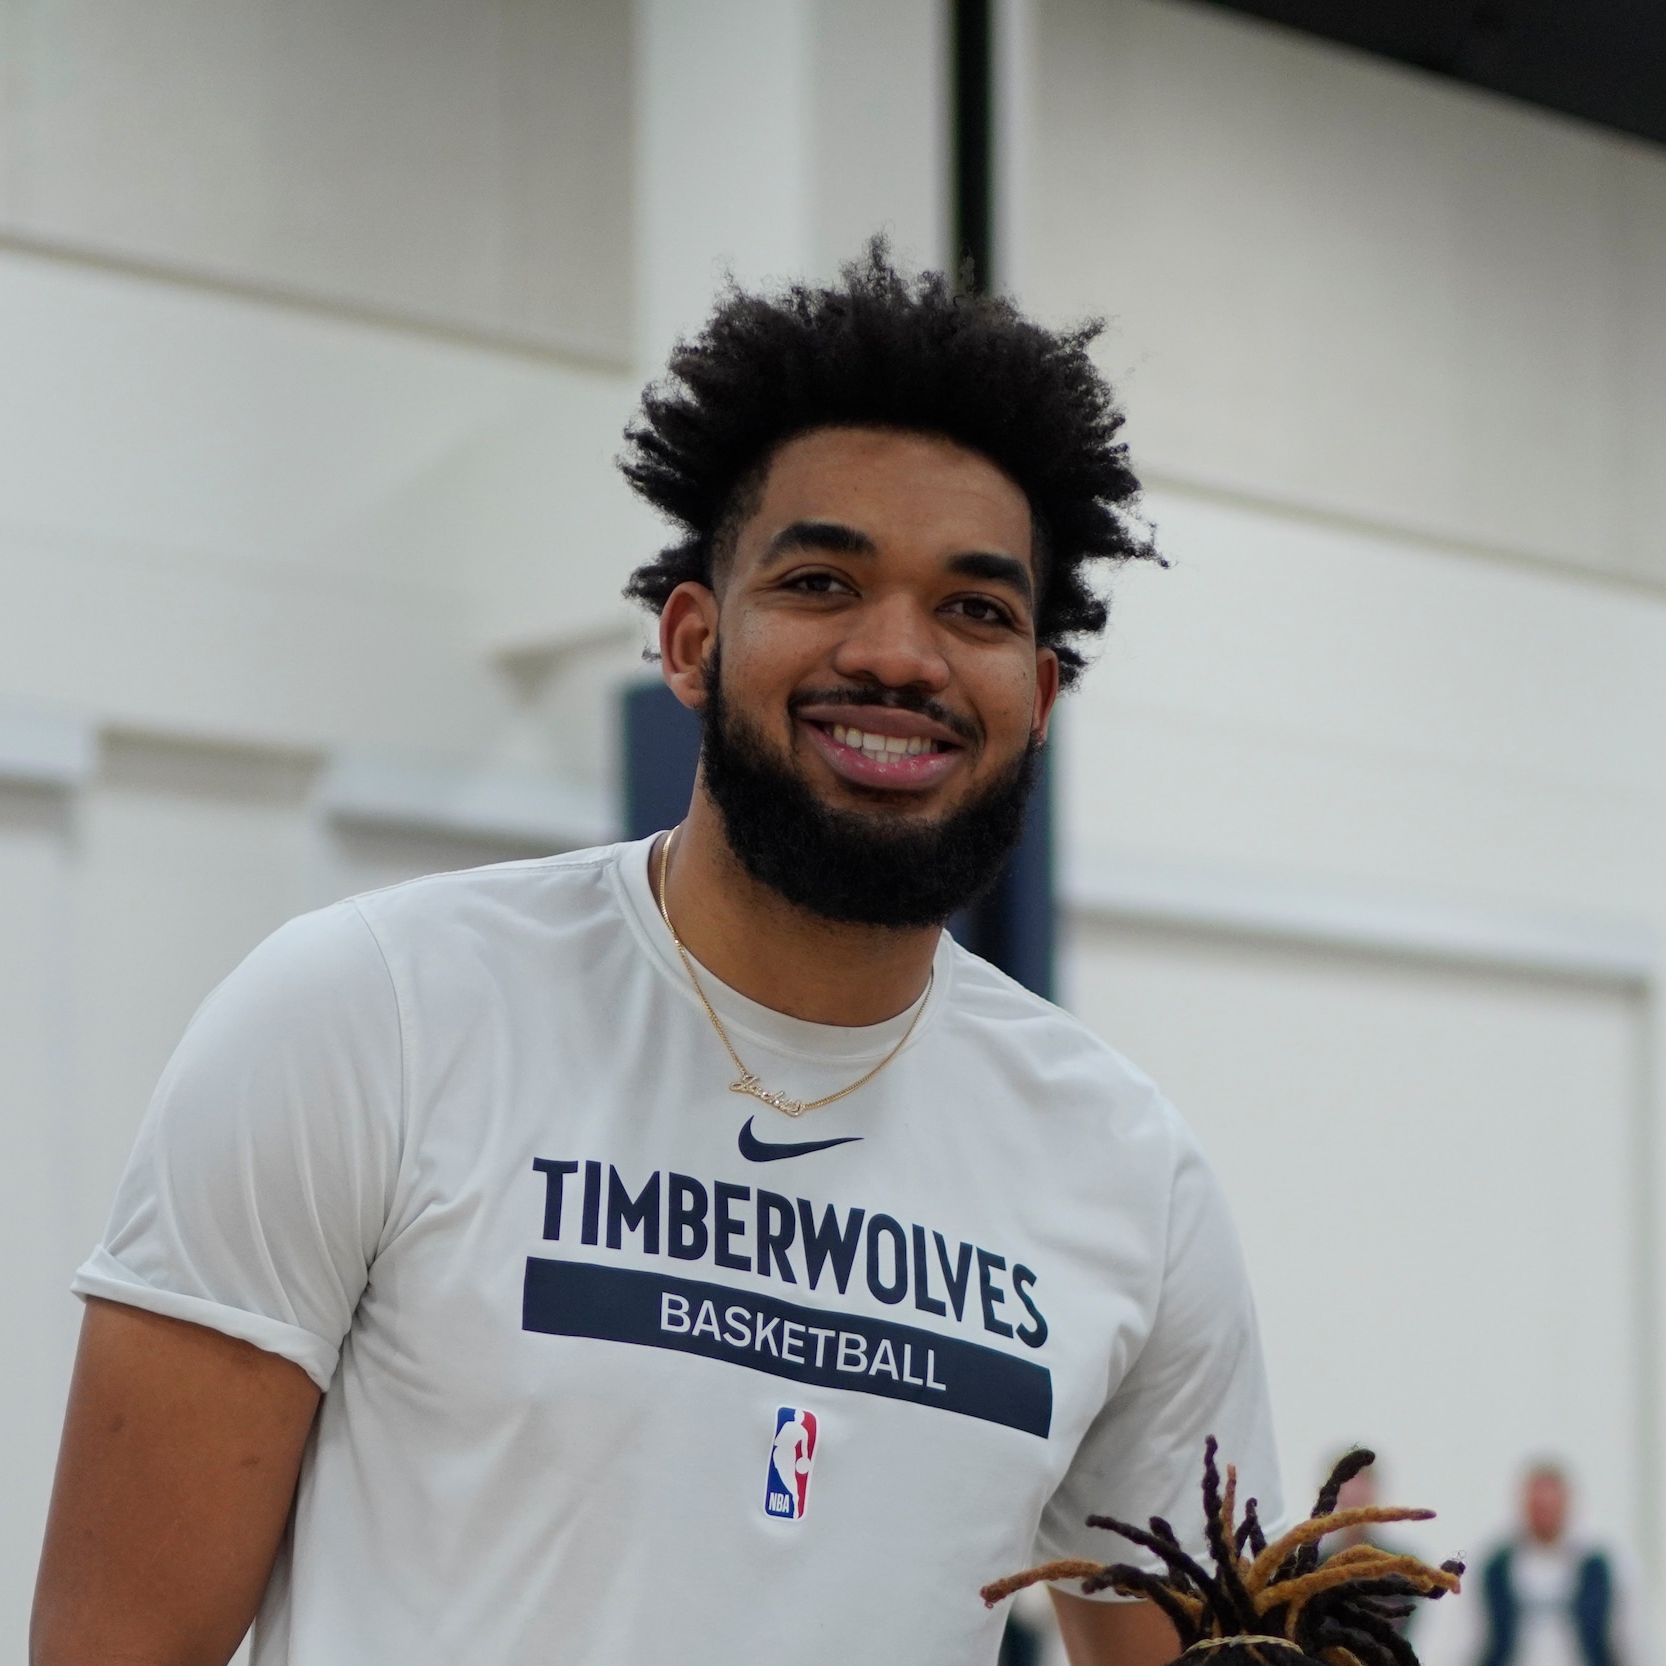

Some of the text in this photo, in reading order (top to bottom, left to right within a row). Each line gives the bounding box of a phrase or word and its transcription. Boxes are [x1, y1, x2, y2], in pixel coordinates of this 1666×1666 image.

[532, 1156, 1049, 1349] TIMBERWOLVES
[659, 1292, 947, 1392] BASKETBALL
[768, 1491, 790, 1514] NBA
